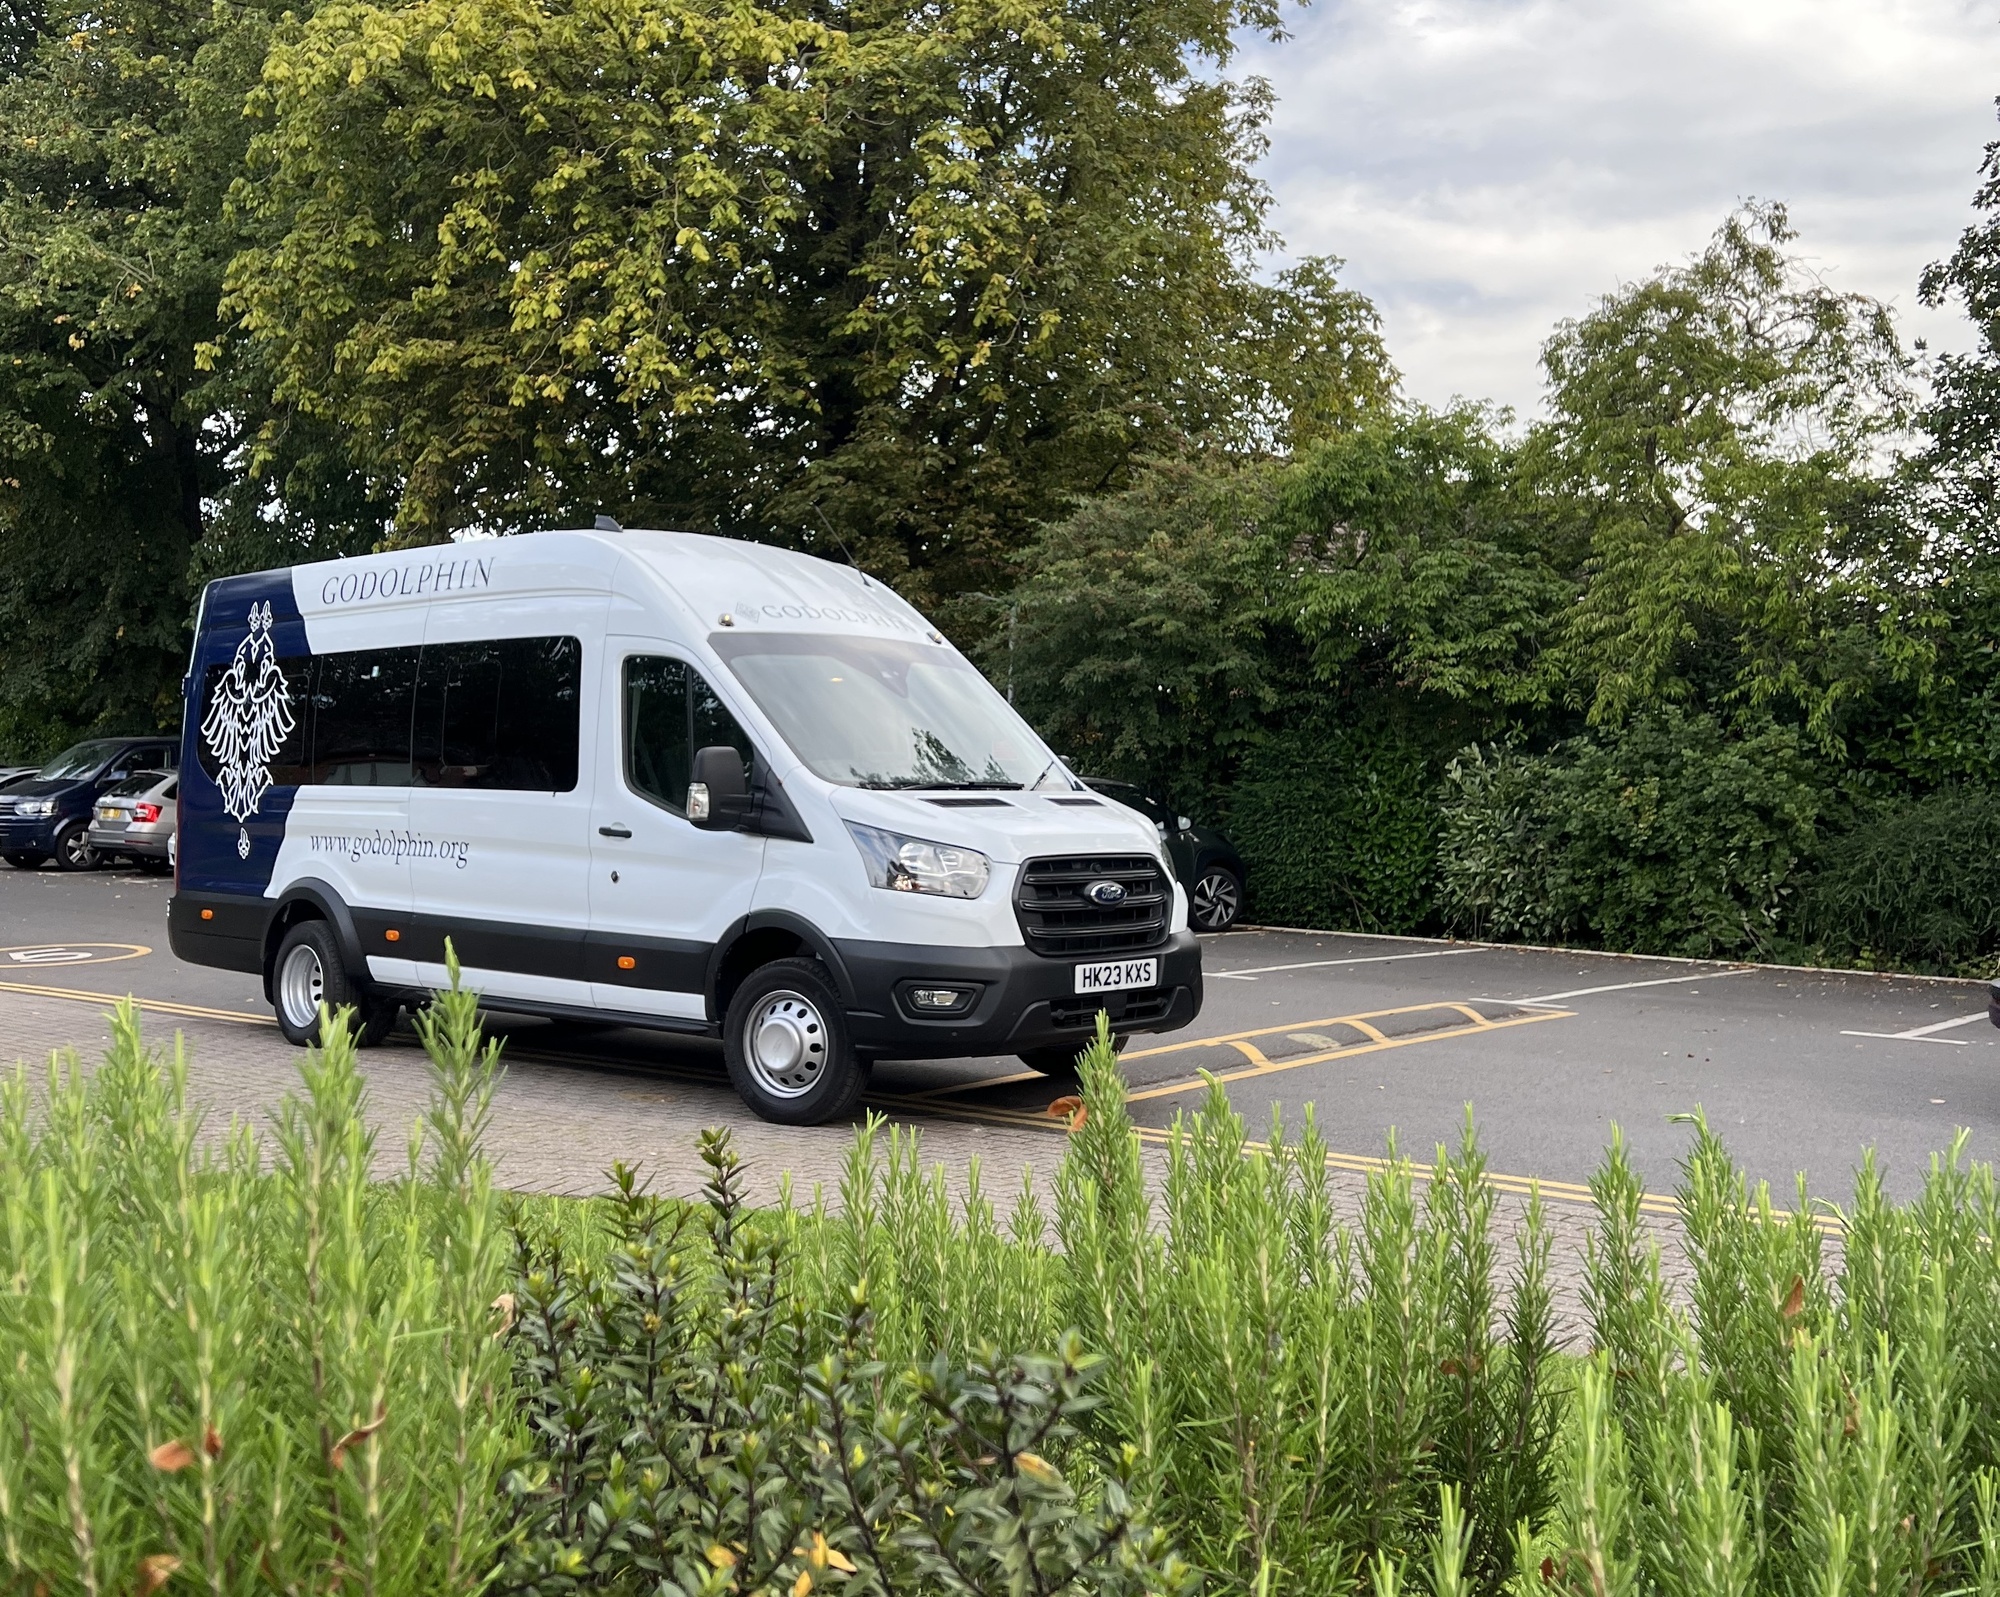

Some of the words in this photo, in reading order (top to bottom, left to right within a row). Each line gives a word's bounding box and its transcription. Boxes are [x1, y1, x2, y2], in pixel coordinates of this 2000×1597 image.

[322, 556, 496, 605] GODOLPHIN
[310, 829, 470, 870] www.godolphin.org
[1082, 965, 1122, 988] HK23
[1125, 962, 1152, 984] KXS
